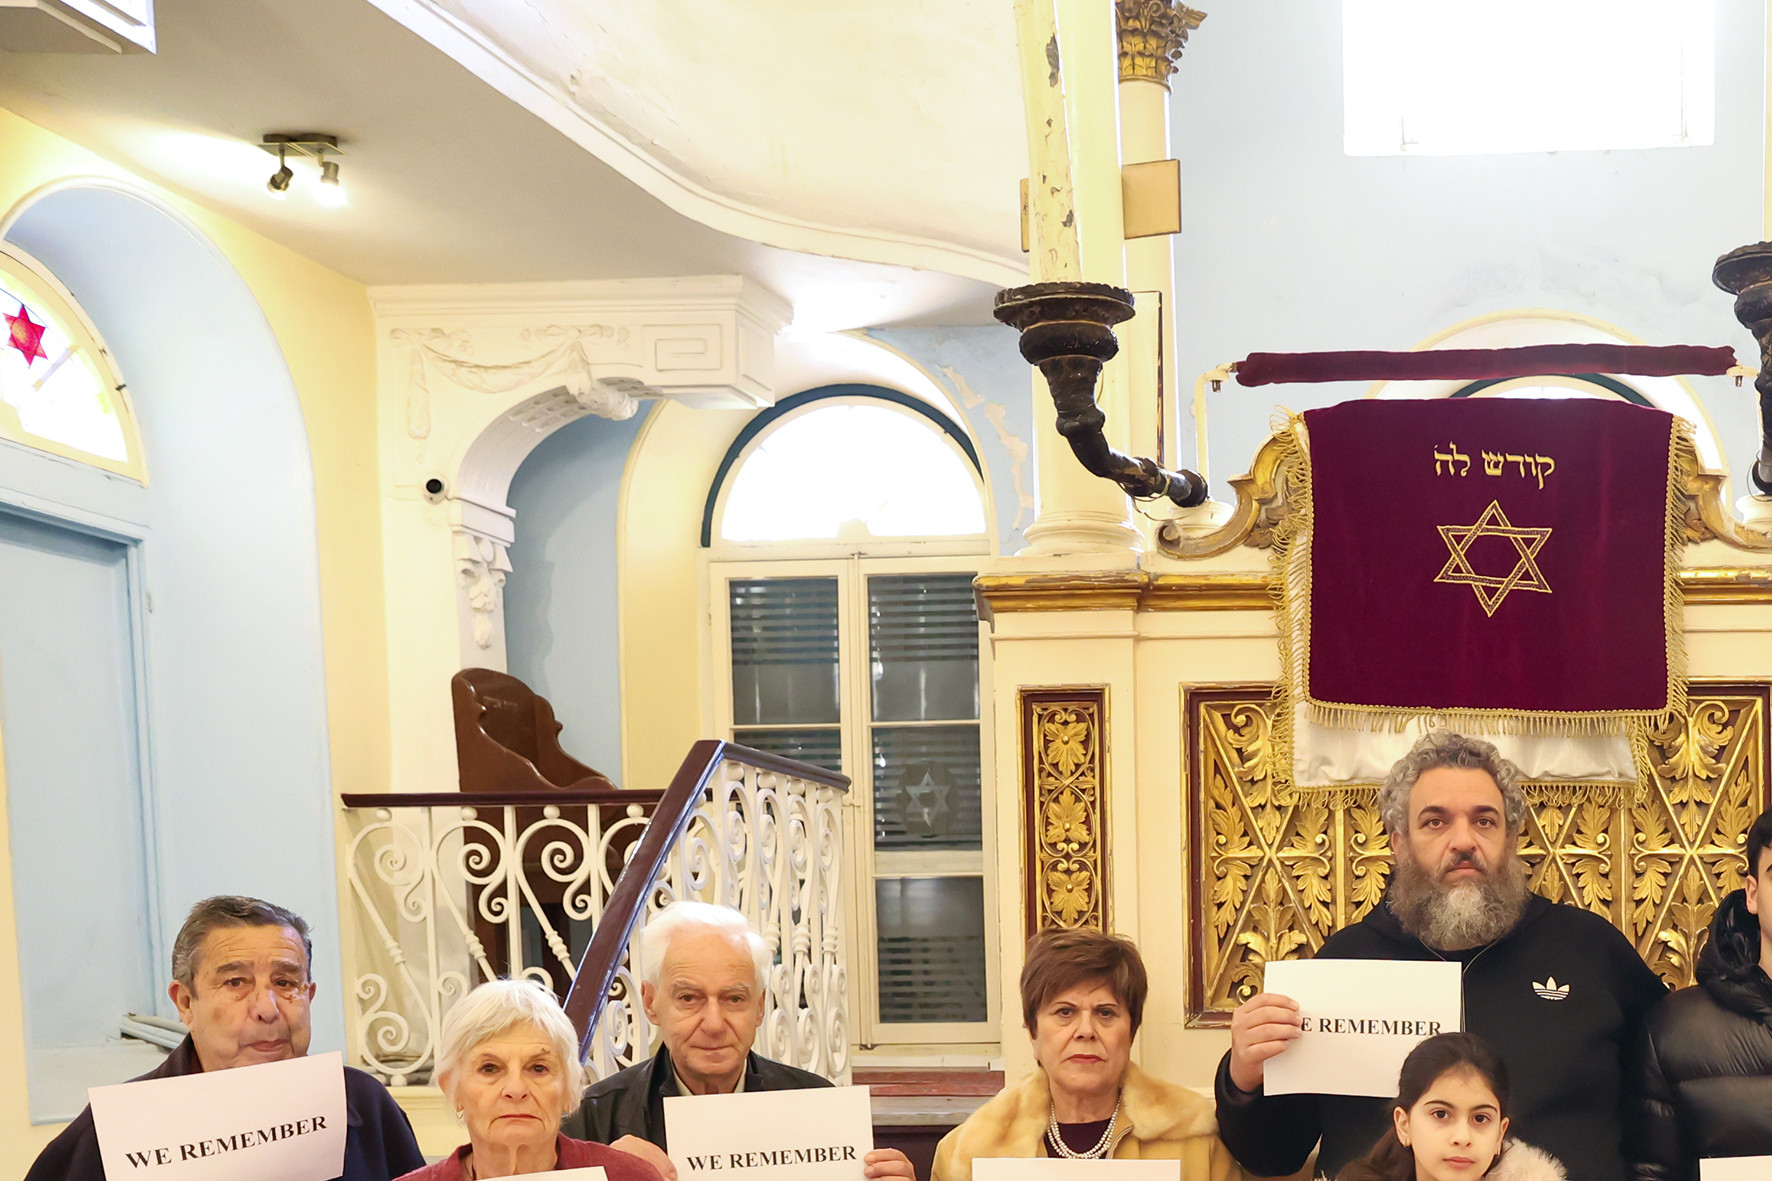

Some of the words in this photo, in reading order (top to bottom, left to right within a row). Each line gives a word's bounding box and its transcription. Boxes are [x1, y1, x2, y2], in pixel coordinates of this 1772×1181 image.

[1481, 449, 1556, 490] קודש
[1300, 1017, 1313, 1032] E
[1318, 1018, 1441, 1036] REMEMBER
[125, 1148, 172, 1168] WE
[180, 1115, 328, 1161] REMEMBER
[687, 1155, 722, 1171] WE
[730, 1146, 856, 1168] REMEMBER
